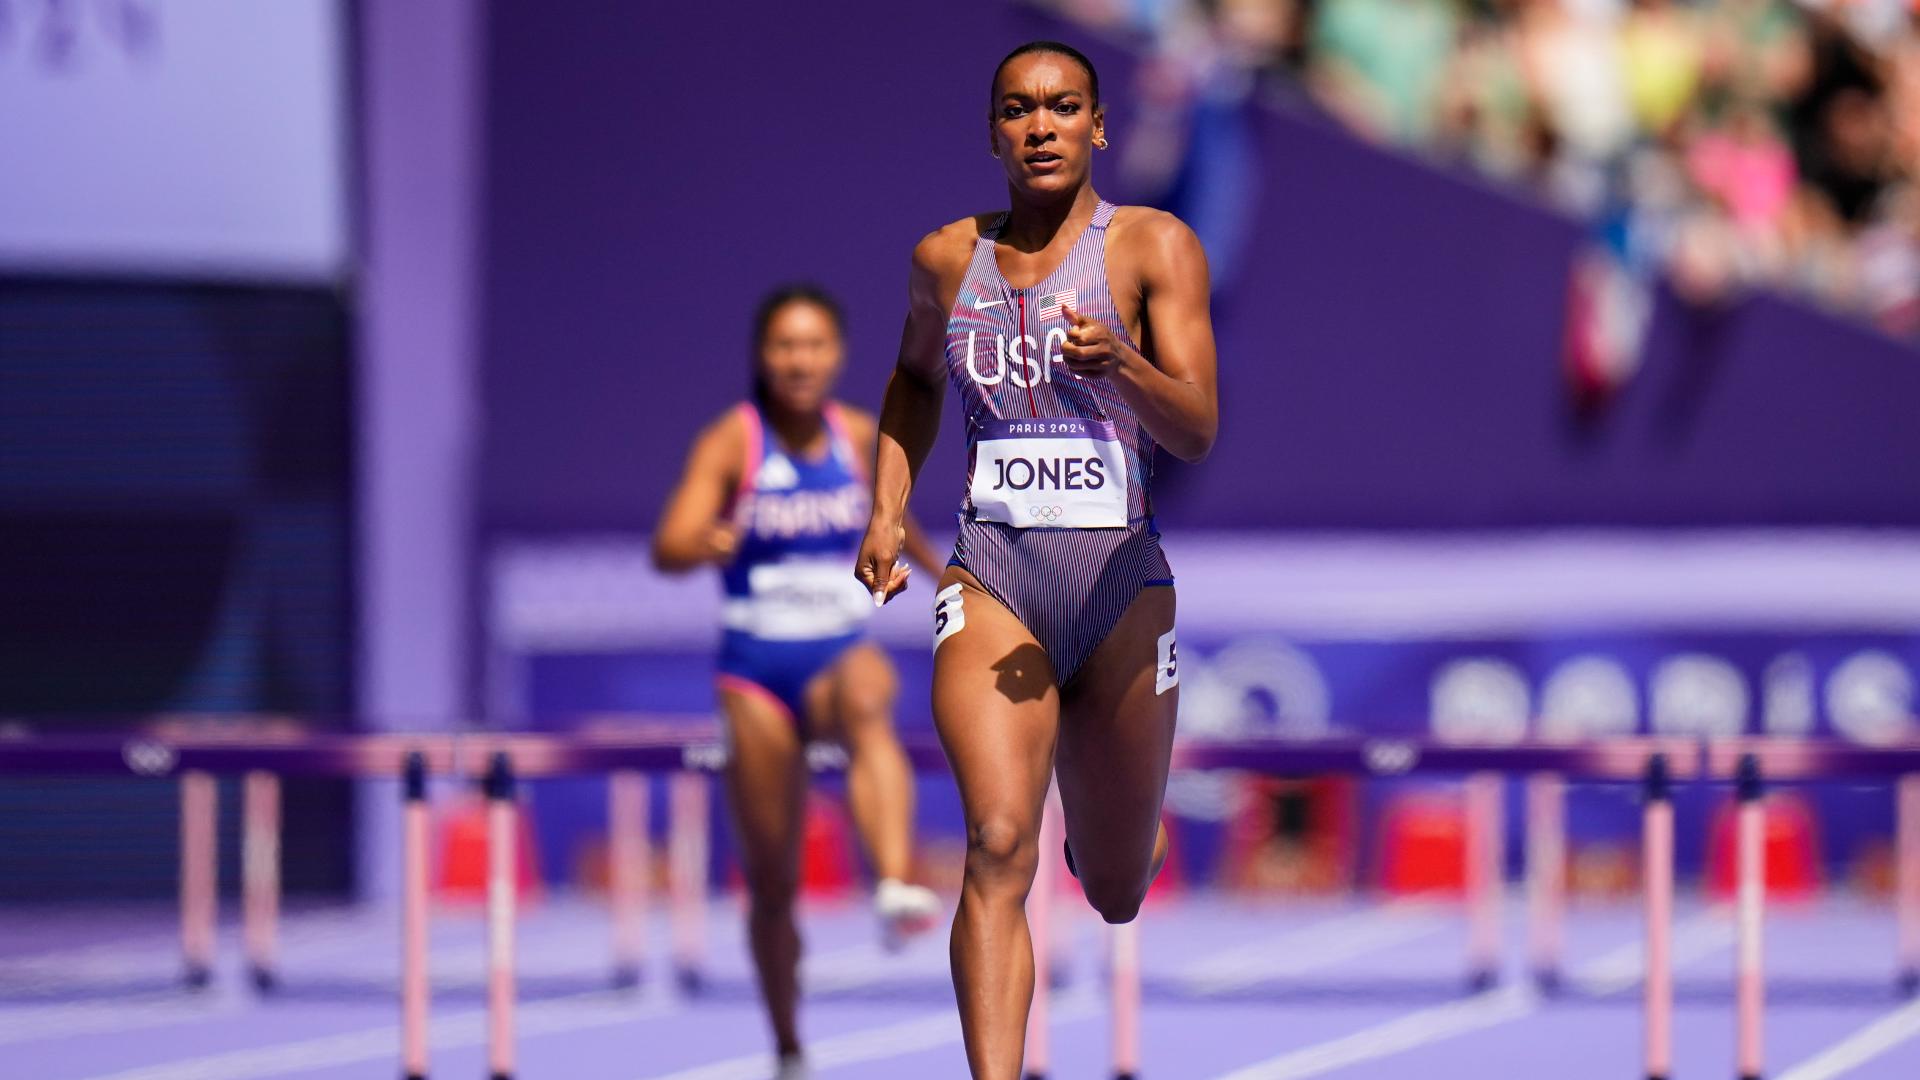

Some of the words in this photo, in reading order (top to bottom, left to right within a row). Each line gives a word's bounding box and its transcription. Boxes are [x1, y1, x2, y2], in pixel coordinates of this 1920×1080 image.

[1009, 423, 1045, 433] PARIS
[1050, 423, 1085, 433] 2024
[993, 457, 1105, 491] JONES
[935, 600, 948, 635] 5
[1167, 641, 1177, 678] 5
